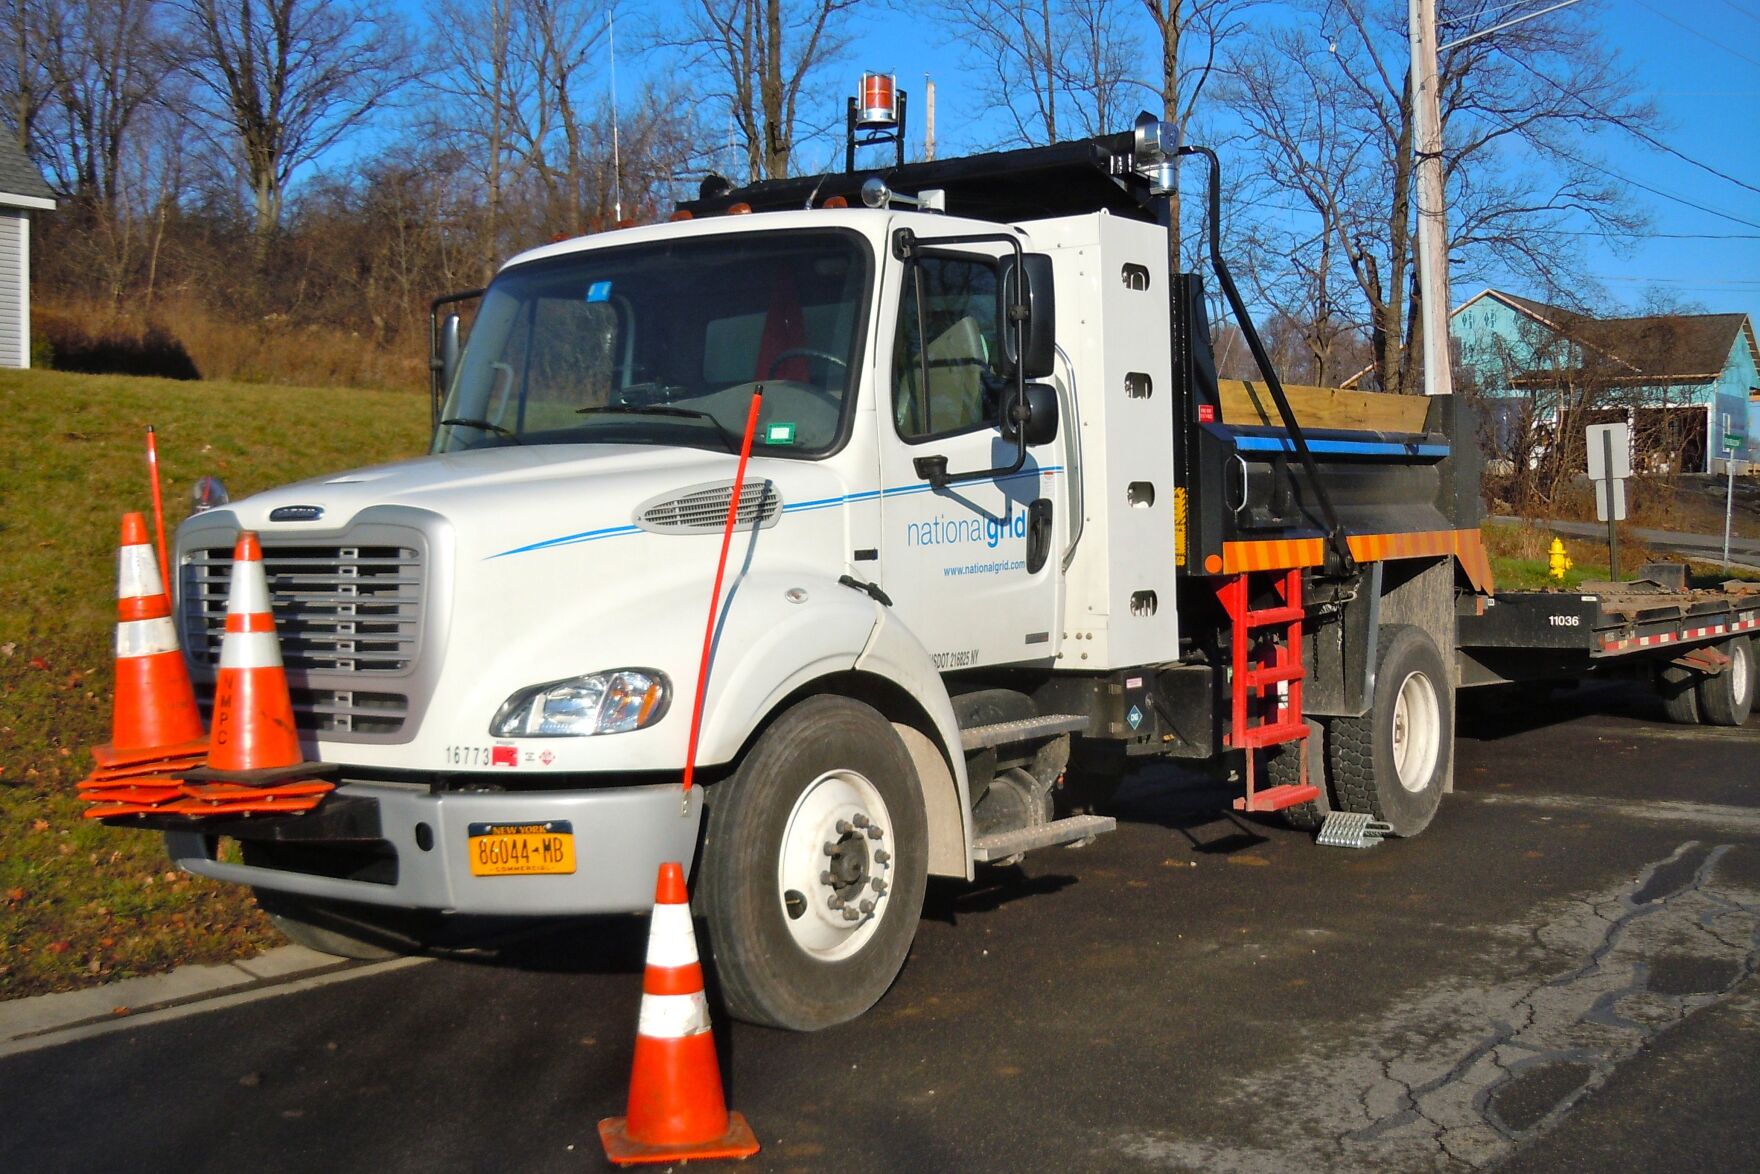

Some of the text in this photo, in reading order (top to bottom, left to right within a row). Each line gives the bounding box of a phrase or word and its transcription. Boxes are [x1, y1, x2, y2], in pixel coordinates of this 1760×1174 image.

[943, 559, 1026, 576] www.nationalgrid.com
[1548, 615, 1579, 626] 11036
[971, 648, 980, 665] NY
[446, 745, 489, 766] 16773
[492, 825, 547, 834] NEW YORK
